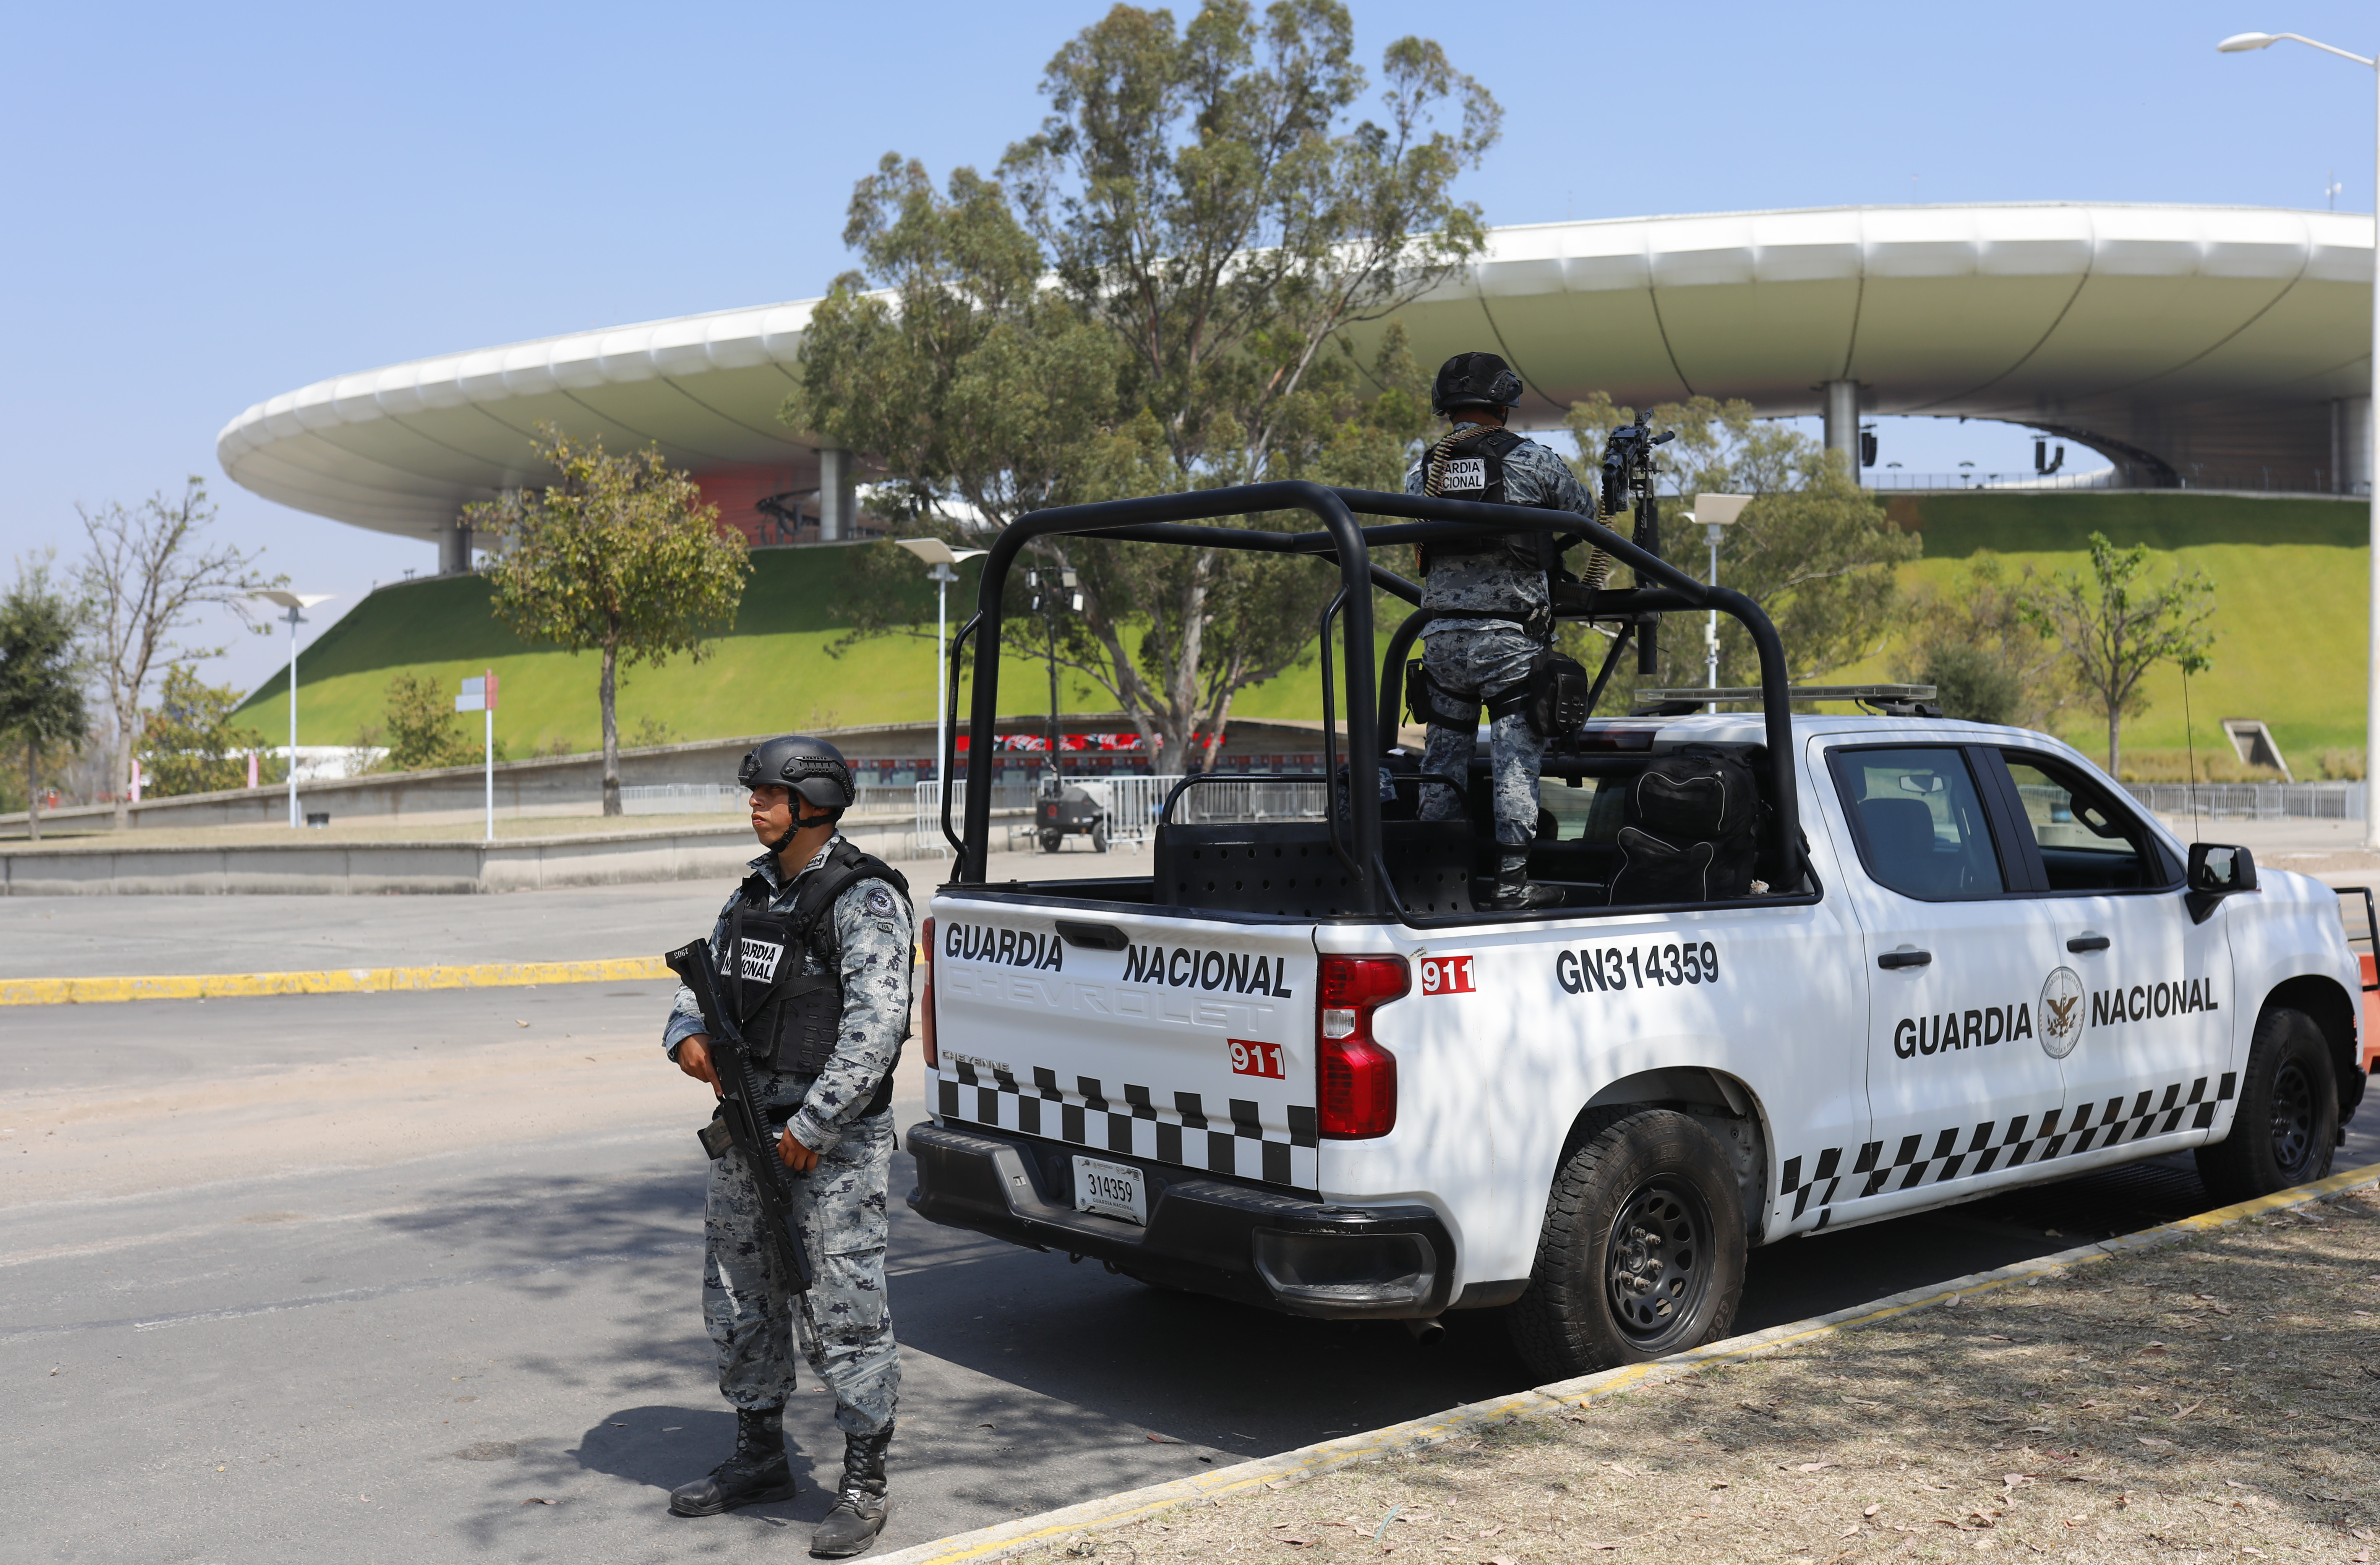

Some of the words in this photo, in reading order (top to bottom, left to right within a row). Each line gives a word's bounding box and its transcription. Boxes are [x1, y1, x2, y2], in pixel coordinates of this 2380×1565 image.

[674, 948, 689, 959] 2905
[945, 922, 1063, 972] GUARDIA
[1122, 945, 1292, 999] NACIONAL
[1422, 959, 1475, 991] 911
[1556, 941, 1719, 994] GN314359
[949, 967, 1274, 1032] CHEVROLET
[1894, 1003, 2033, 1059] GUARDIA
[2092, 978, 2218, 1027] NACIONAL
[942, 1050, 1009, 1072] CHEYENNE
[1230, 1043, 1284, 1075] 911
[2045, 1041, 2063, 1054] JUSTICIA
[1088, 1173, 1132, 1202] 314359
[1603, 1144, 1678, 1218] WRANGLER
[1112, 1202, 1134, 1212] NACIONAL
